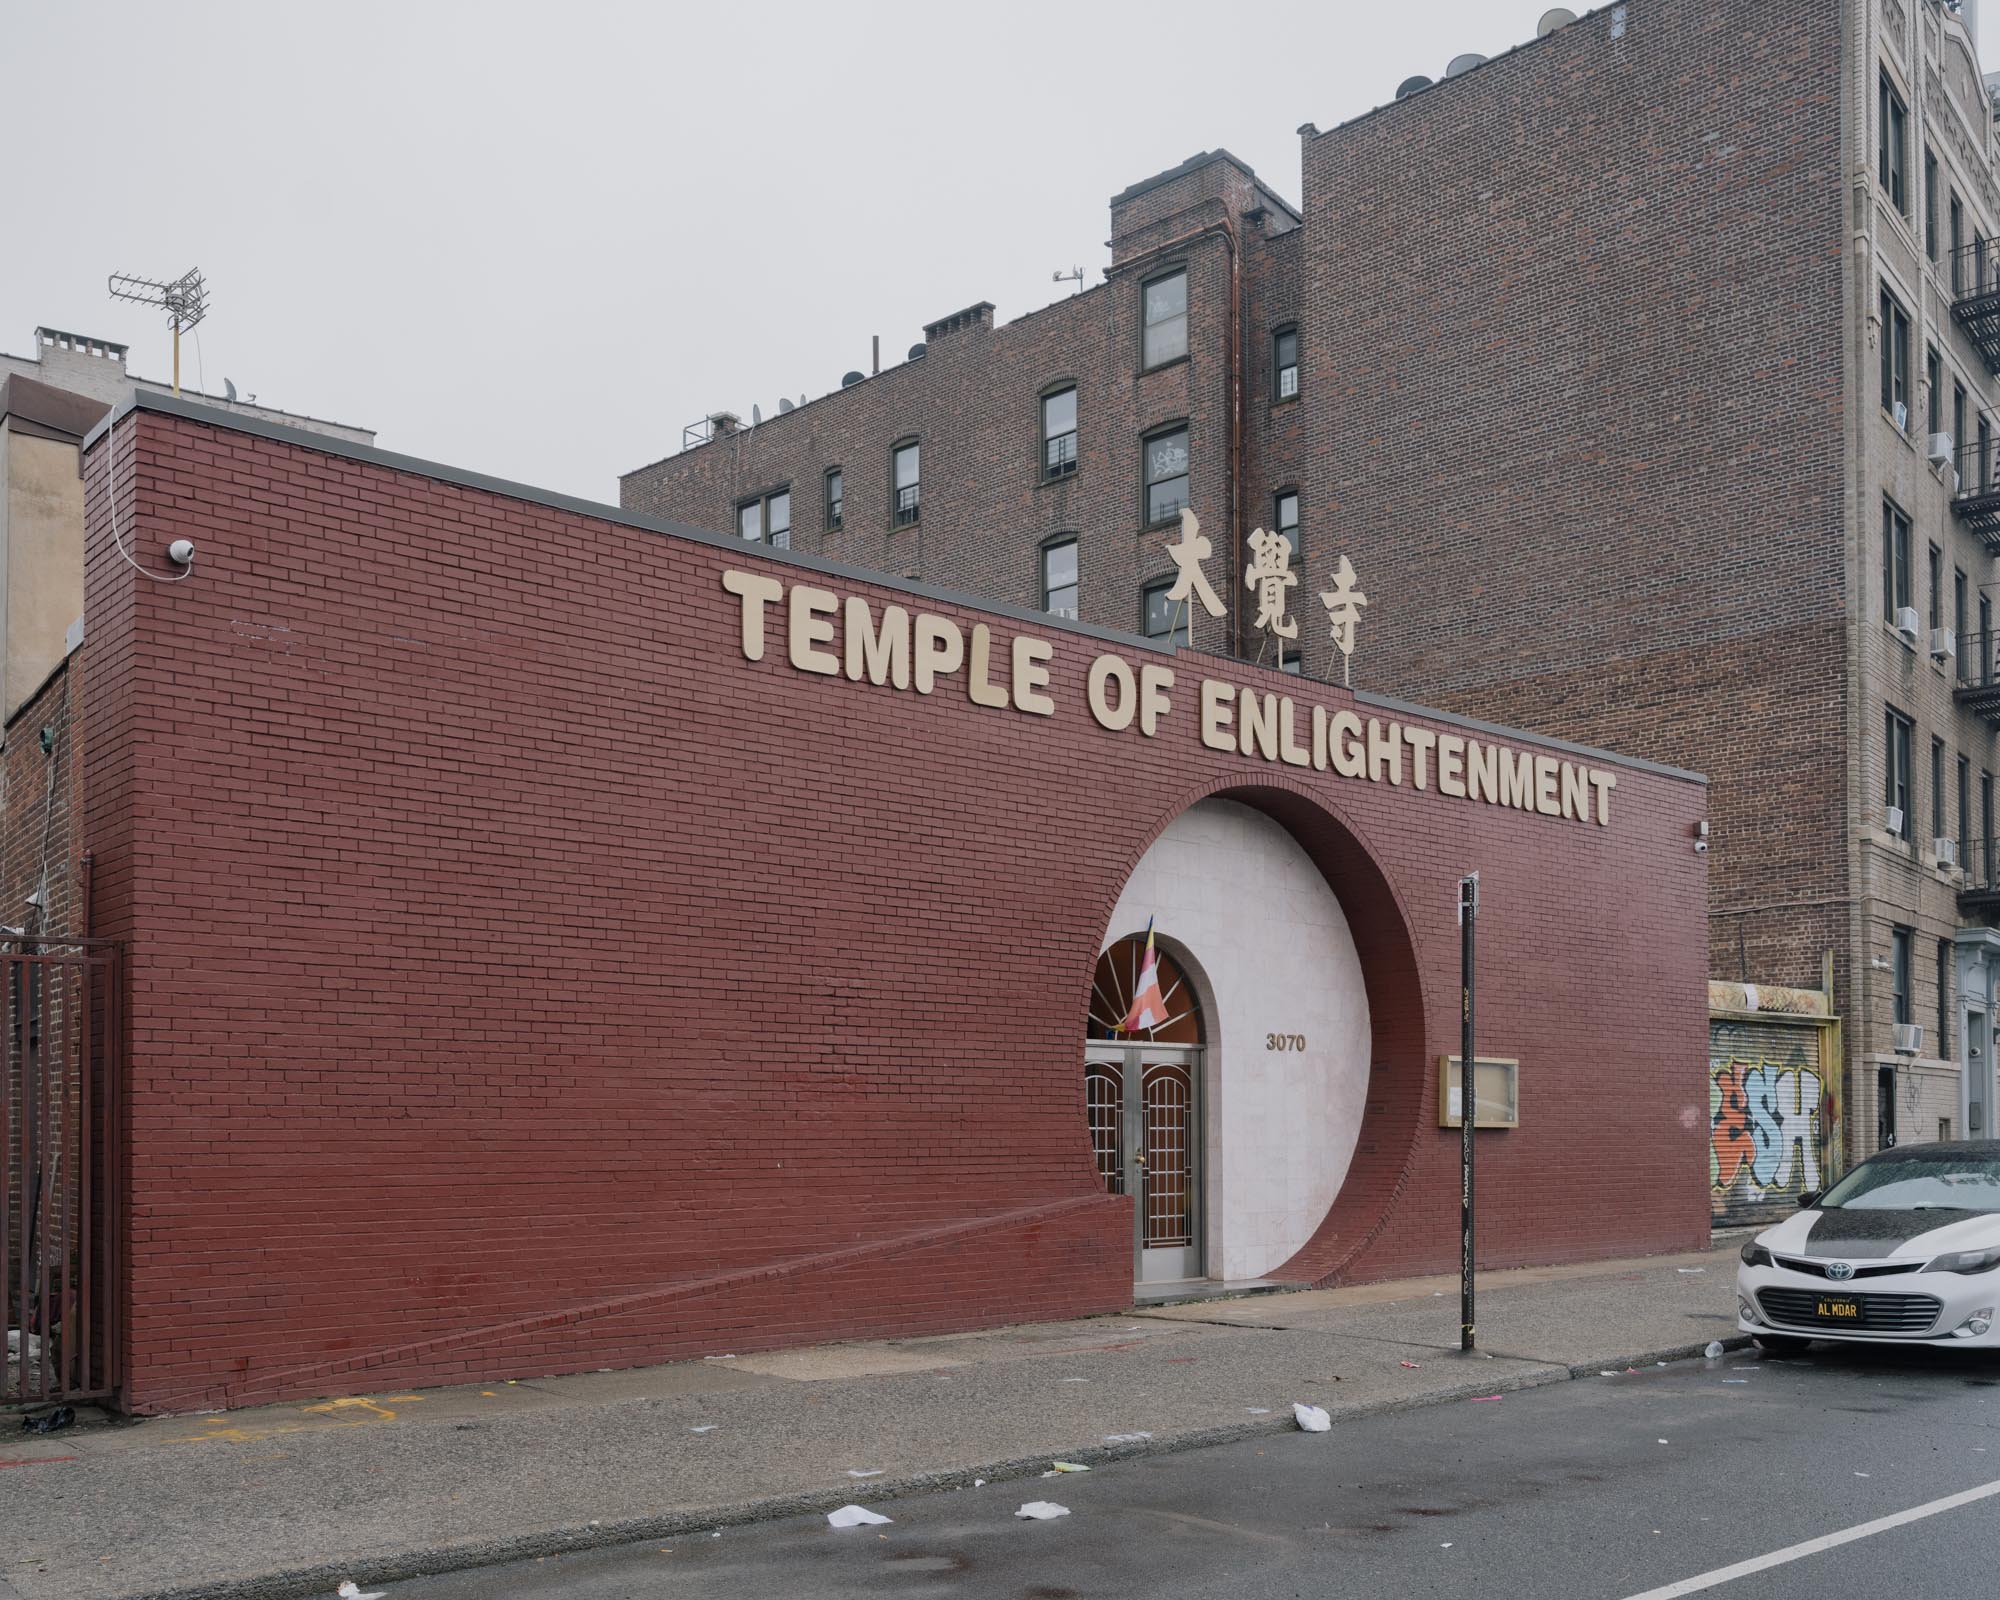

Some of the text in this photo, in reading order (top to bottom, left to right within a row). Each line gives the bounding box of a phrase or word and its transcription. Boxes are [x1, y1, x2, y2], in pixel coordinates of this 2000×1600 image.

[1165, 507, 1368, 655] 大覺寺
[722, 569, 1617, 827] TEMPLE OF ENLIGHTENMENT
[1266, 1032, 1306, 1052] 3070
[1818, 1303, 1857, 1317] AL MDAR
